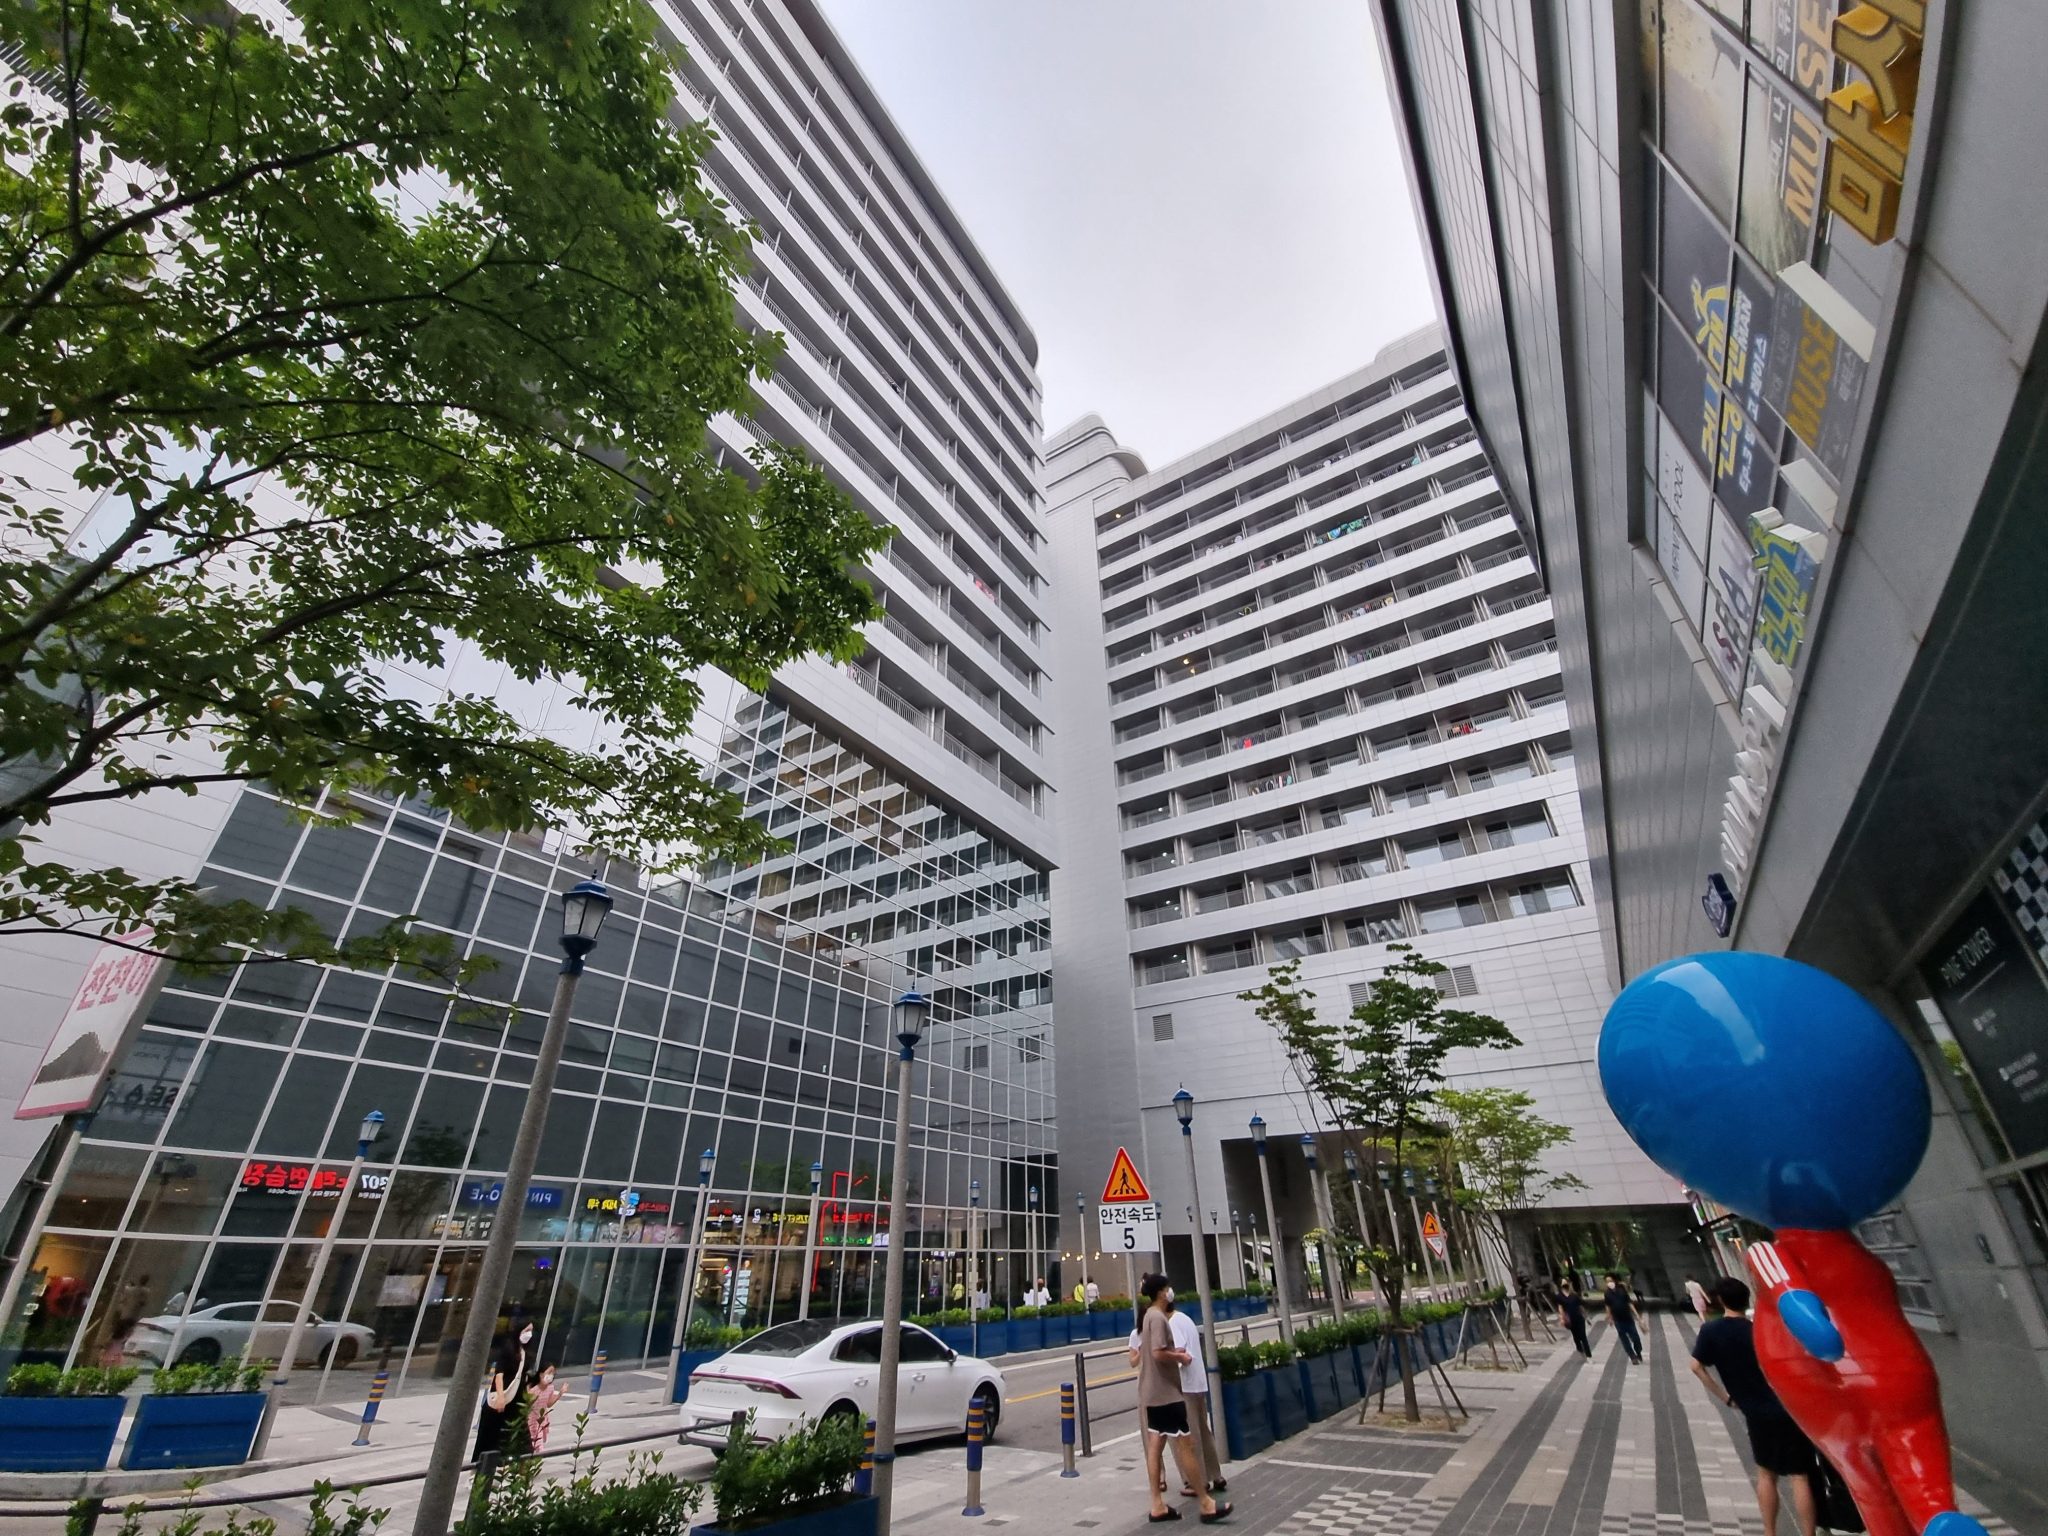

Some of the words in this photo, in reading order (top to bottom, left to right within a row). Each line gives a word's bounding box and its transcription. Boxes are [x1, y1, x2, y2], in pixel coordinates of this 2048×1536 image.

[1784, 0, 1832, 228] MUSE
[1957, 926, 1997, 970] TOWER
[1101, 1207, 1156, 1225] 안전속도
[1124, 1227, 1135, 1250] 5
